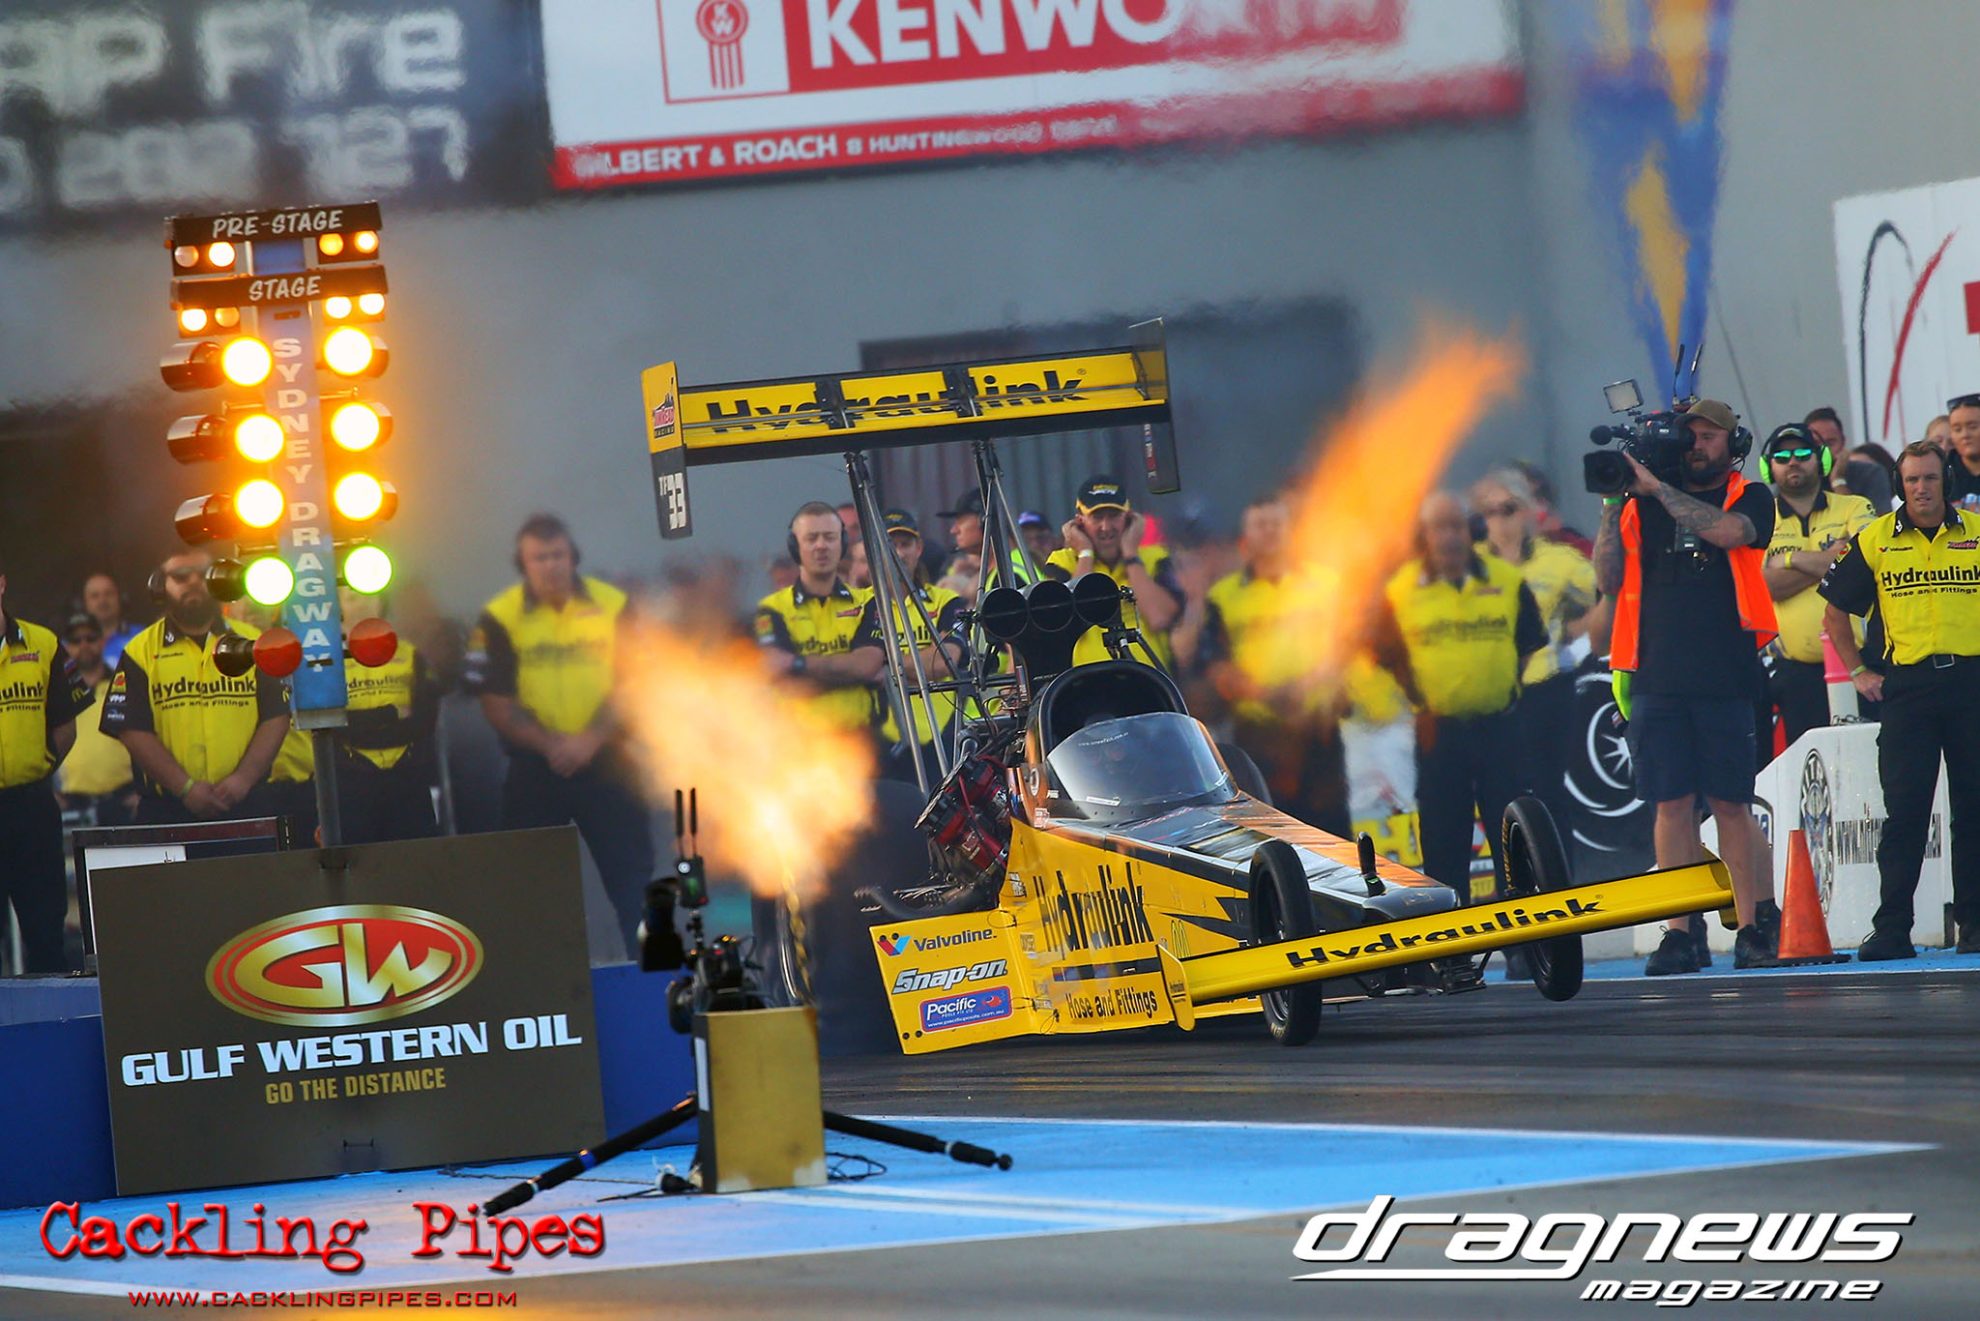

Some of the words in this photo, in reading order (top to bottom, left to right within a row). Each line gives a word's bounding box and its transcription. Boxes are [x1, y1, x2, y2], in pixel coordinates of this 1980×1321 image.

[574, 145, 704, 178] LBERT
[709, 146, 726, 167] &
[733, 133, 838, 165] ROACH
[212, 209, 344, 239] PRE-STAGE
[249, 275, 322, 302] STAGE
[272, 336, 314, 485] SYDNEY
[289, 500, 333, 673] DRAGWAY
[1891, 590, 1914, 598] Hose
[152, 676, 256, 699] Hydraulink
[1032, 861, 1154, 961] Hydraulink
[1285, 896, 1608, 970] Hydraulink
[234, 922, 456, 1009] GW
[892, 959, 1008, 995] Snap-on
[926, 997, 977, 1021] Pacific
[1065, 992, 1094, 1020] Hose
[1094, 989, 1115, 1018] and
[1115, 986, 1157, 1019] Fittings
[121, 1045, 244, 1087] GULF
[257, 1021, 488, 1074] WESTERN
[503, 1014, 583, 1051] OIL
[265, 1083, 293, 1104] GO
[300, 1078, 338, 1101] THE
[345, 1067, 446, 1097] DISTANCE
